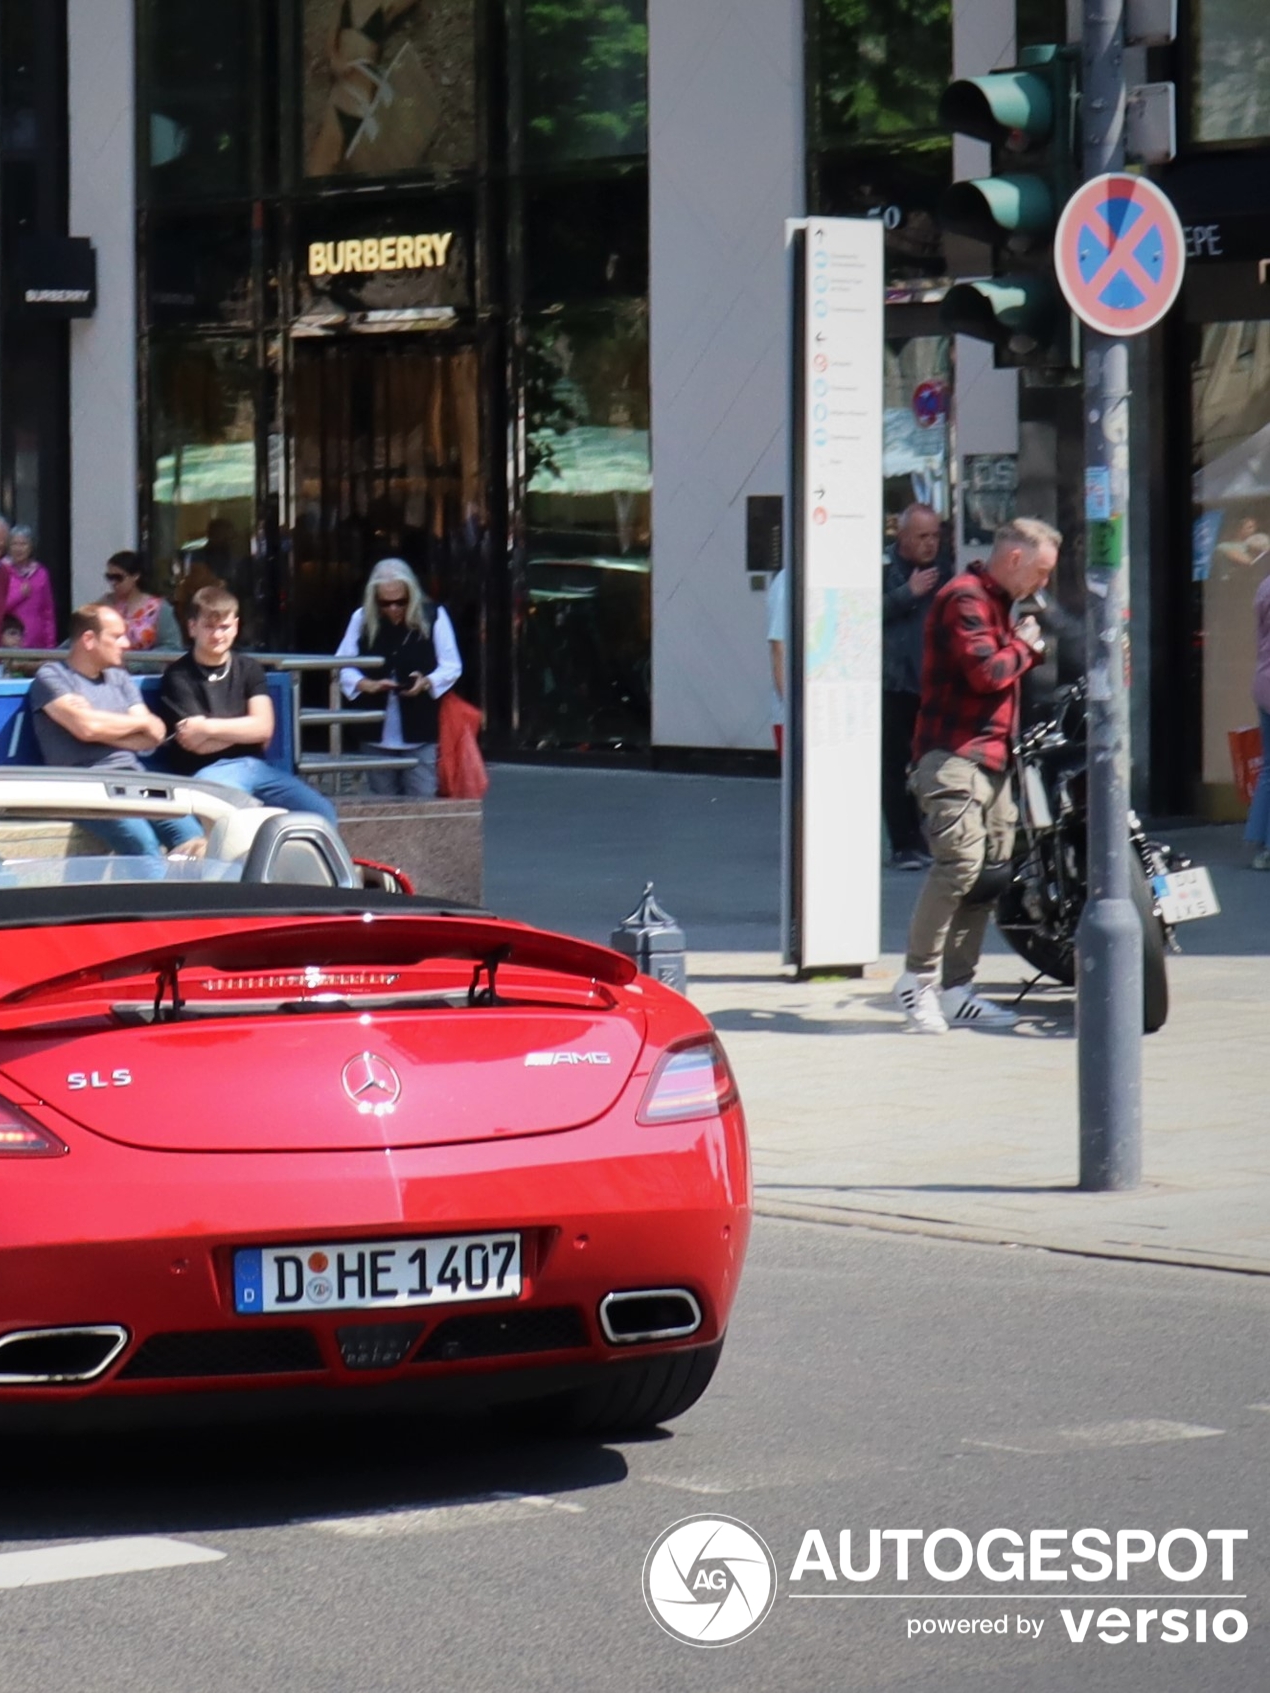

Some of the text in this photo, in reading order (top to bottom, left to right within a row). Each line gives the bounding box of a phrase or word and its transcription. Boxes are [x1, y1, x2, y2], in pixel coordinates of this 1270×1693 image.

[308, 232, 452, 276] BURBERRY
[550, 1051, 611, 1065] AMG
[67, 1068, 132, 1091] SLS
[273, 1240, 517, 1304] D HE 1407
